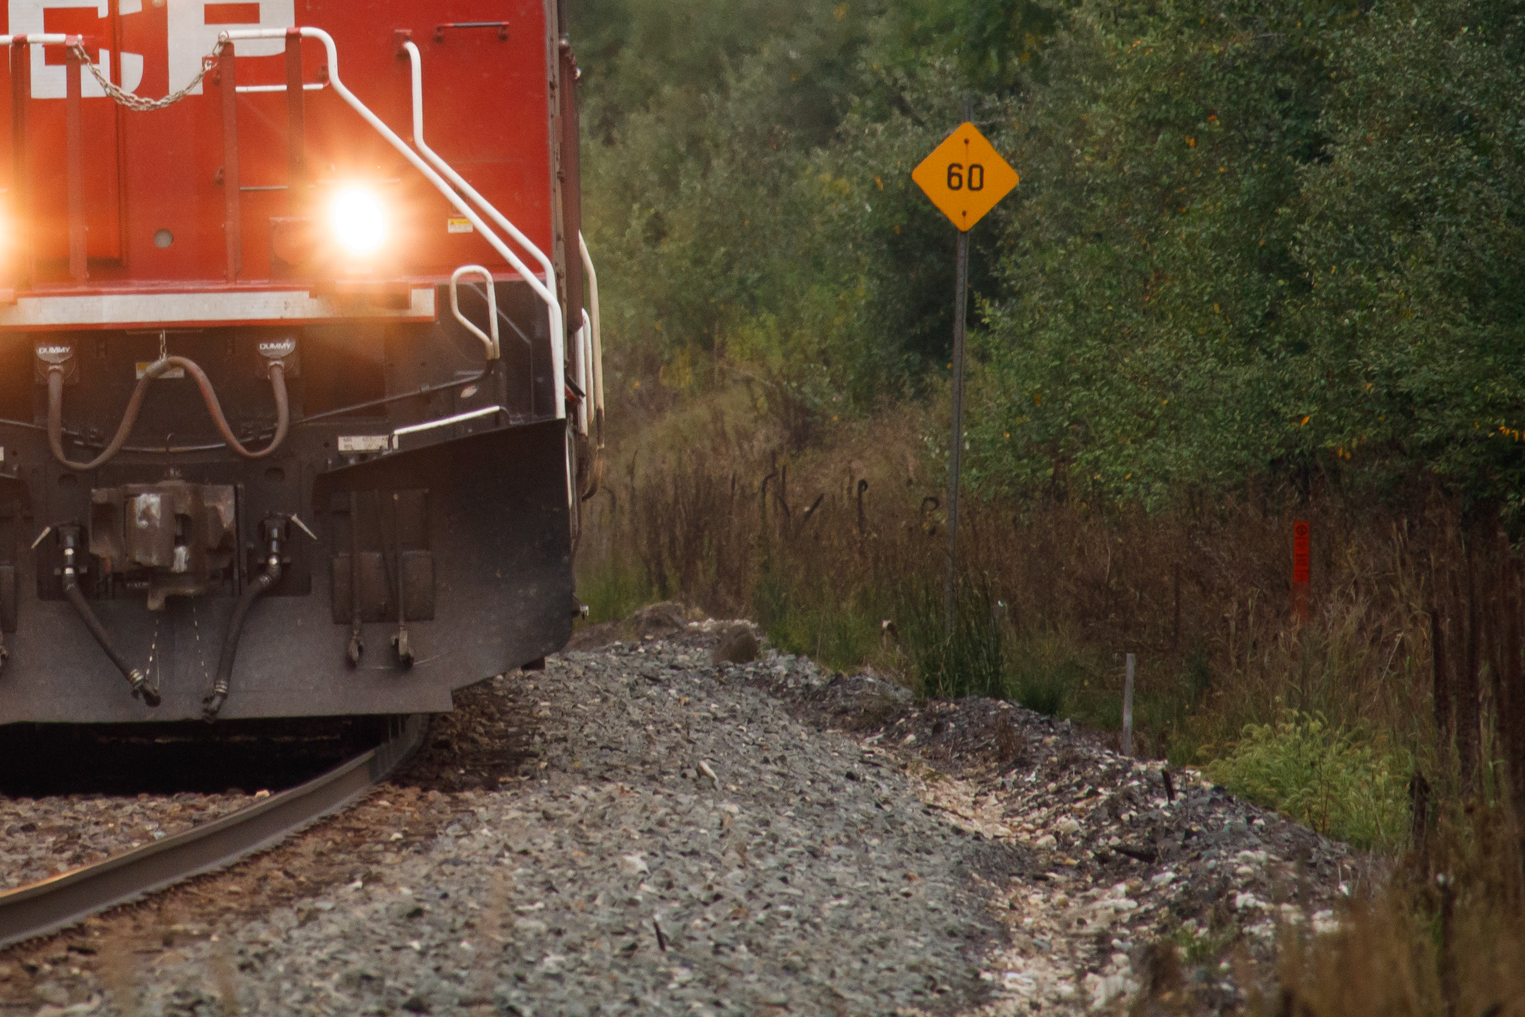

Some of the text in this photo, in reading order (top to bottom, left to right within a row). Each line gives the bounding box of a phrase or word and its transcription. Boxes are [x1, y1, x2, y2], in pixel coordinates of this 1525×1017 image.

[946, 162, 985, 192] 60
[38, 345, 71, 354] DUMMY
[259, 342, 292, 350] DUMMY
